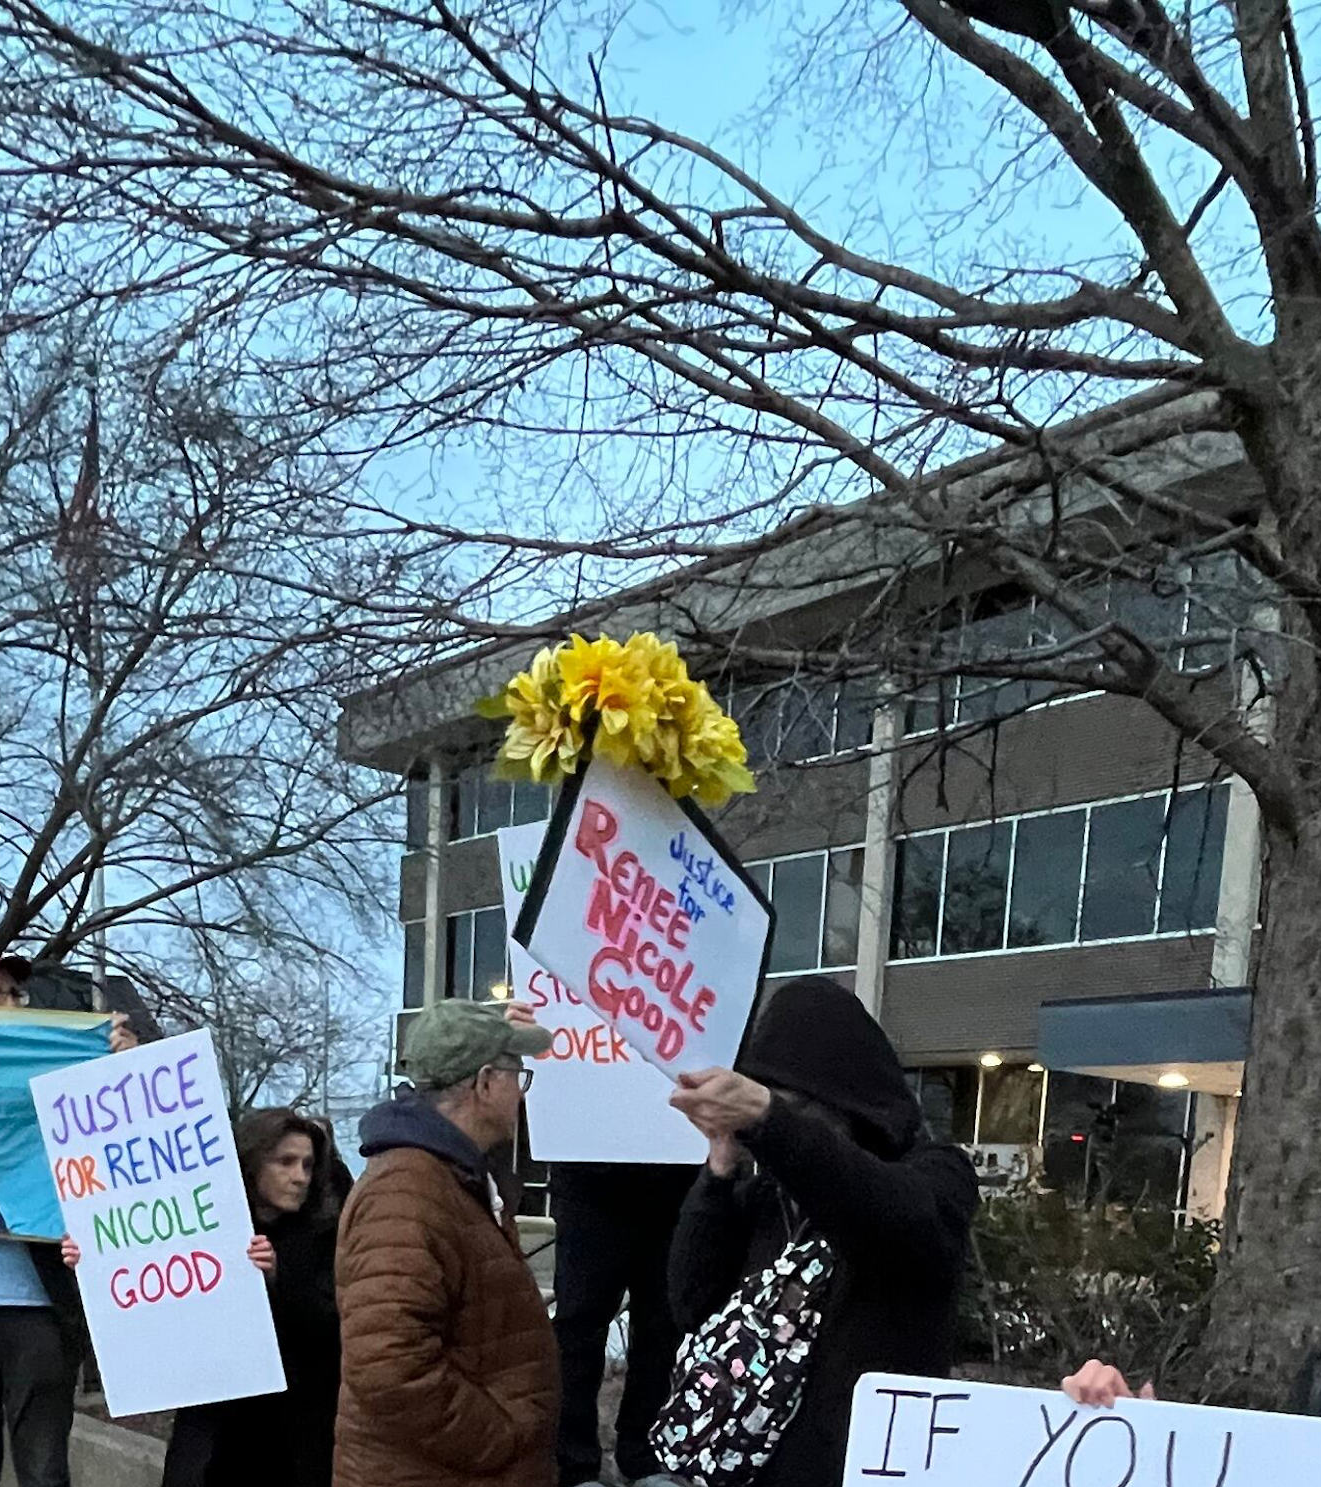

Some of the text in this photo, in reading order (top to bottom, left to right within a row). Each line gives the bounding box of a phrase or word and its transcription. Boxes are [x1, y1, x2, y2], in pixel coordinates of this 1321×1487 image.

[533, 1024, 630, 1063] OVER
[51, 1052, 204, 1145] JUSTICE
[54, 1113, 225, 1202] FOR RENEE
[93, 1182, 220, 1255] NICOLE
[110, 1250, 222, 1309] GOOD
[861, 1387, 971, 1477] IF
